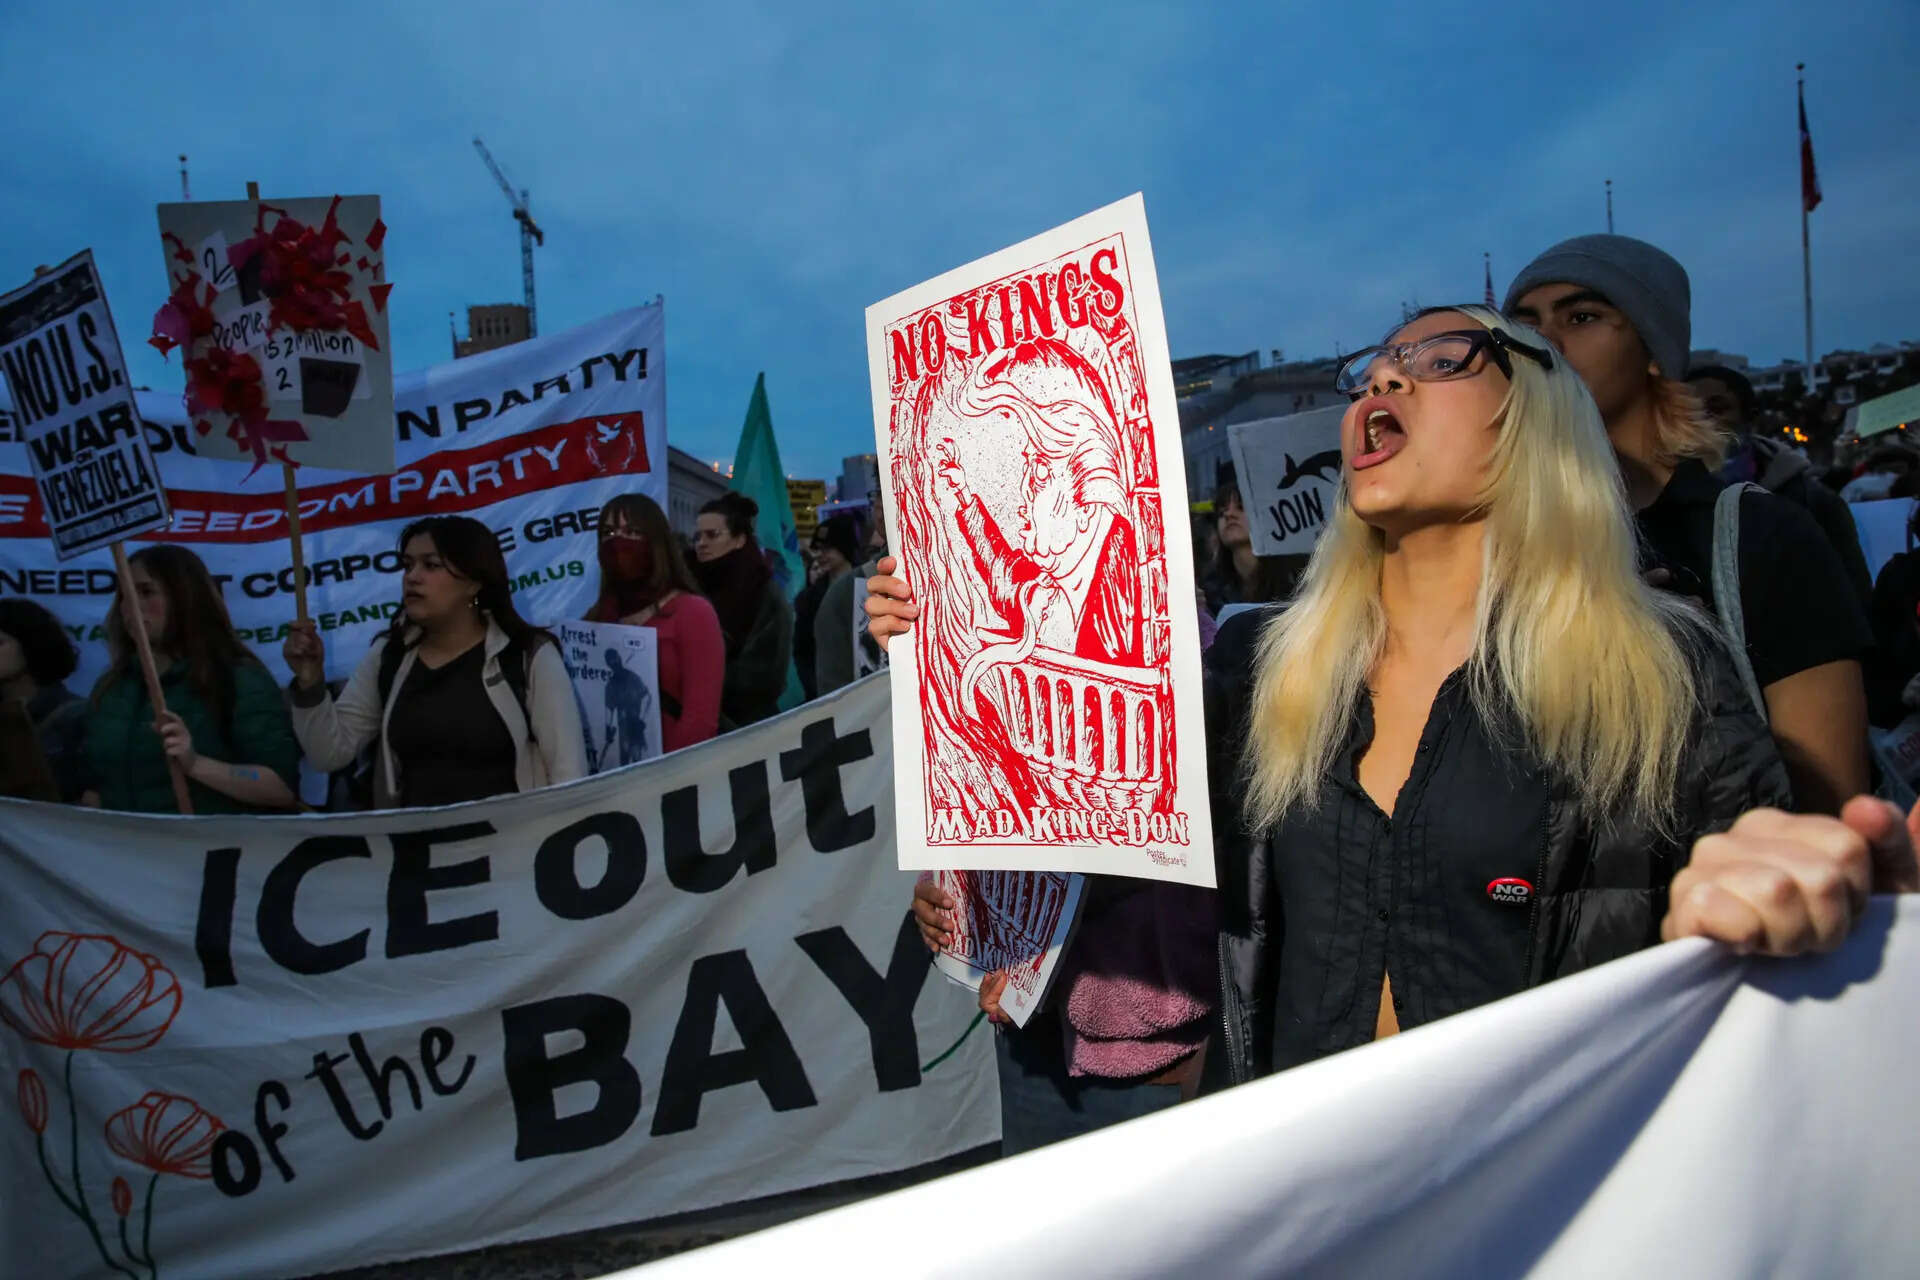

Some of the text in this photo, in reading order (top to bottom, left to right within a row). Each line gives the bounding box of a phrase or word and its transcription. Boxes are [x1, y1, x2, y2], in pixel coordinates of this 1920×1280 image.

[889, 247, 1125, 386] NO KINGS
[2, 311, 123, 427] NO U.S.
[276, 368, 293, 391] 2
[453, 347, 648, 432] PARTY!
[29, 401, 139, 472] WAR
[41, 444, 155, 525] VENEZUELA
[389, 438, 568, 502] PARTY
[1268, 486, 1326, 542] JOIN
[0, 568, 118, 595] NEED
[560, 625, 597, 647] Arrest
[194, 716, 877, 989] ICE out
[927, 806, 1016, 845] MAD
[1492, 893, 1528, 903] WAR
[1495, 883, 1529, 896] NO
[209, 911, 935, 1198] of the BAY
